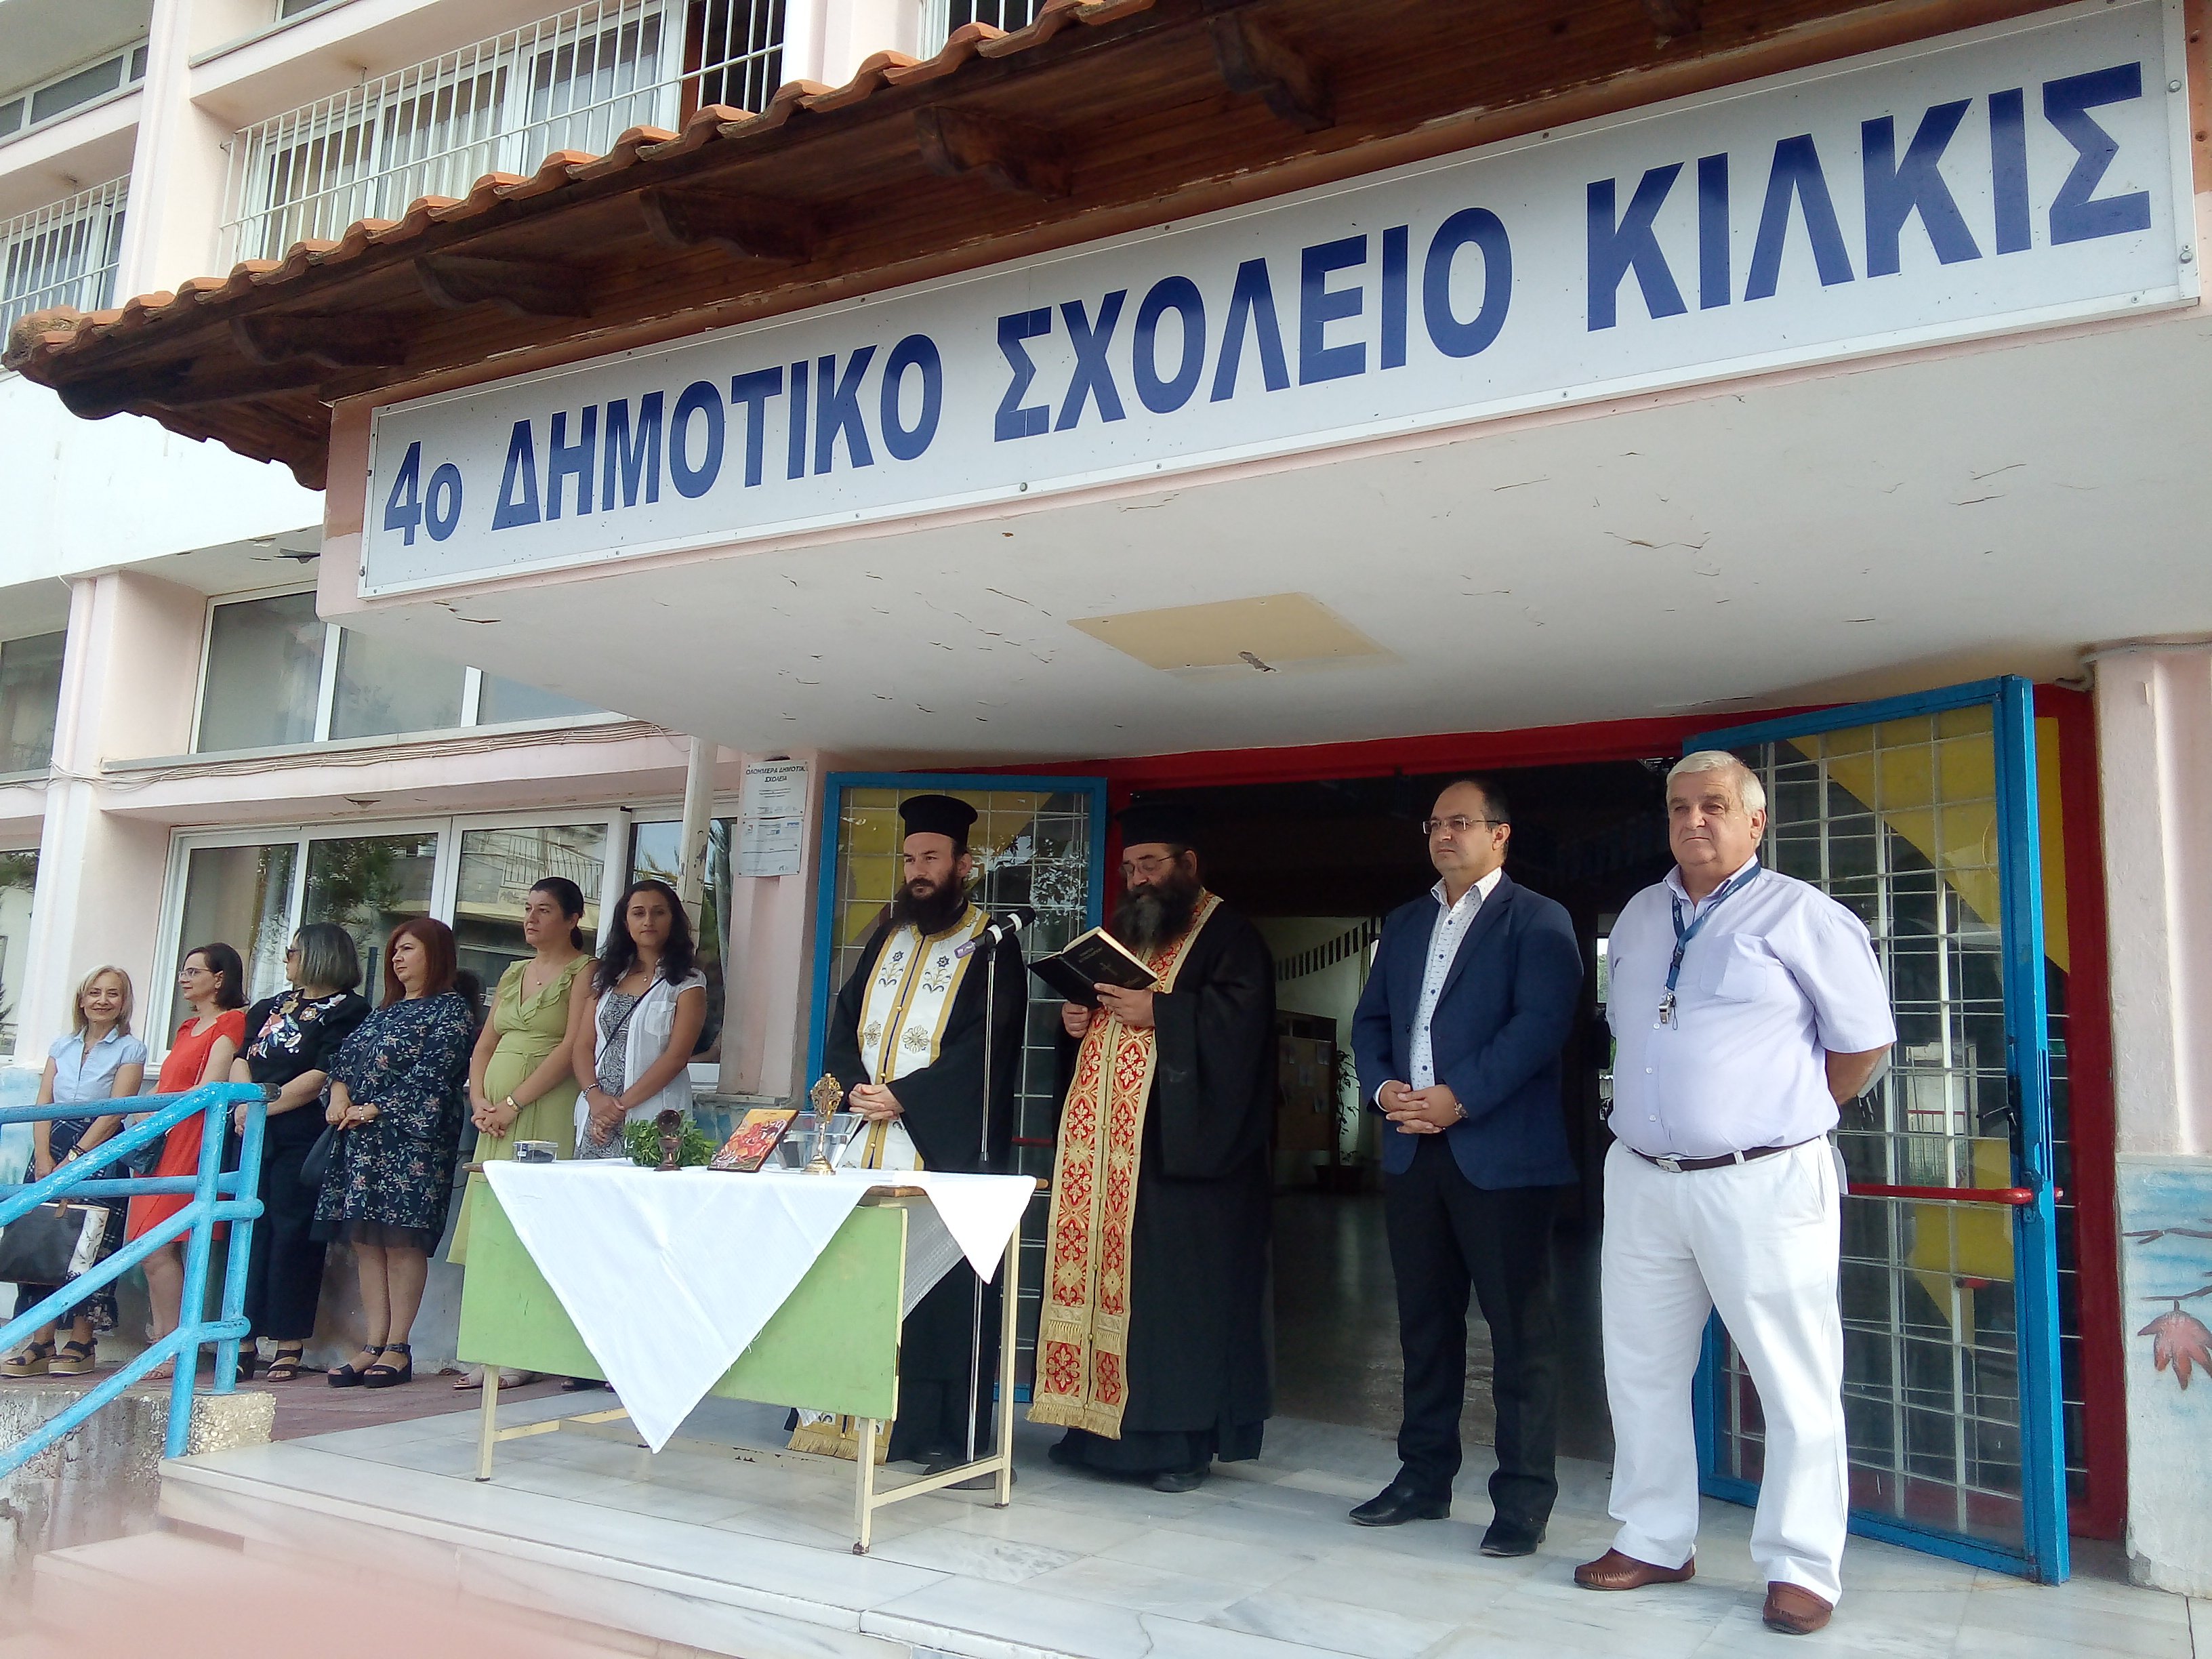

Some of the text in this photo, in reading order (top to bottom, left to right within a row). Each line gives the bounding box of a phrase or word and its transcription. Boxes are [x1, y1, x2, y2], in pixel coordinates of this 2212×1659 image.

[384, 61, 2152, 546] 4ο ΔΗΜΟΤΙΚΟ ΣΧΟΛΕΙΟ ΚΙΛΚΙΣ
